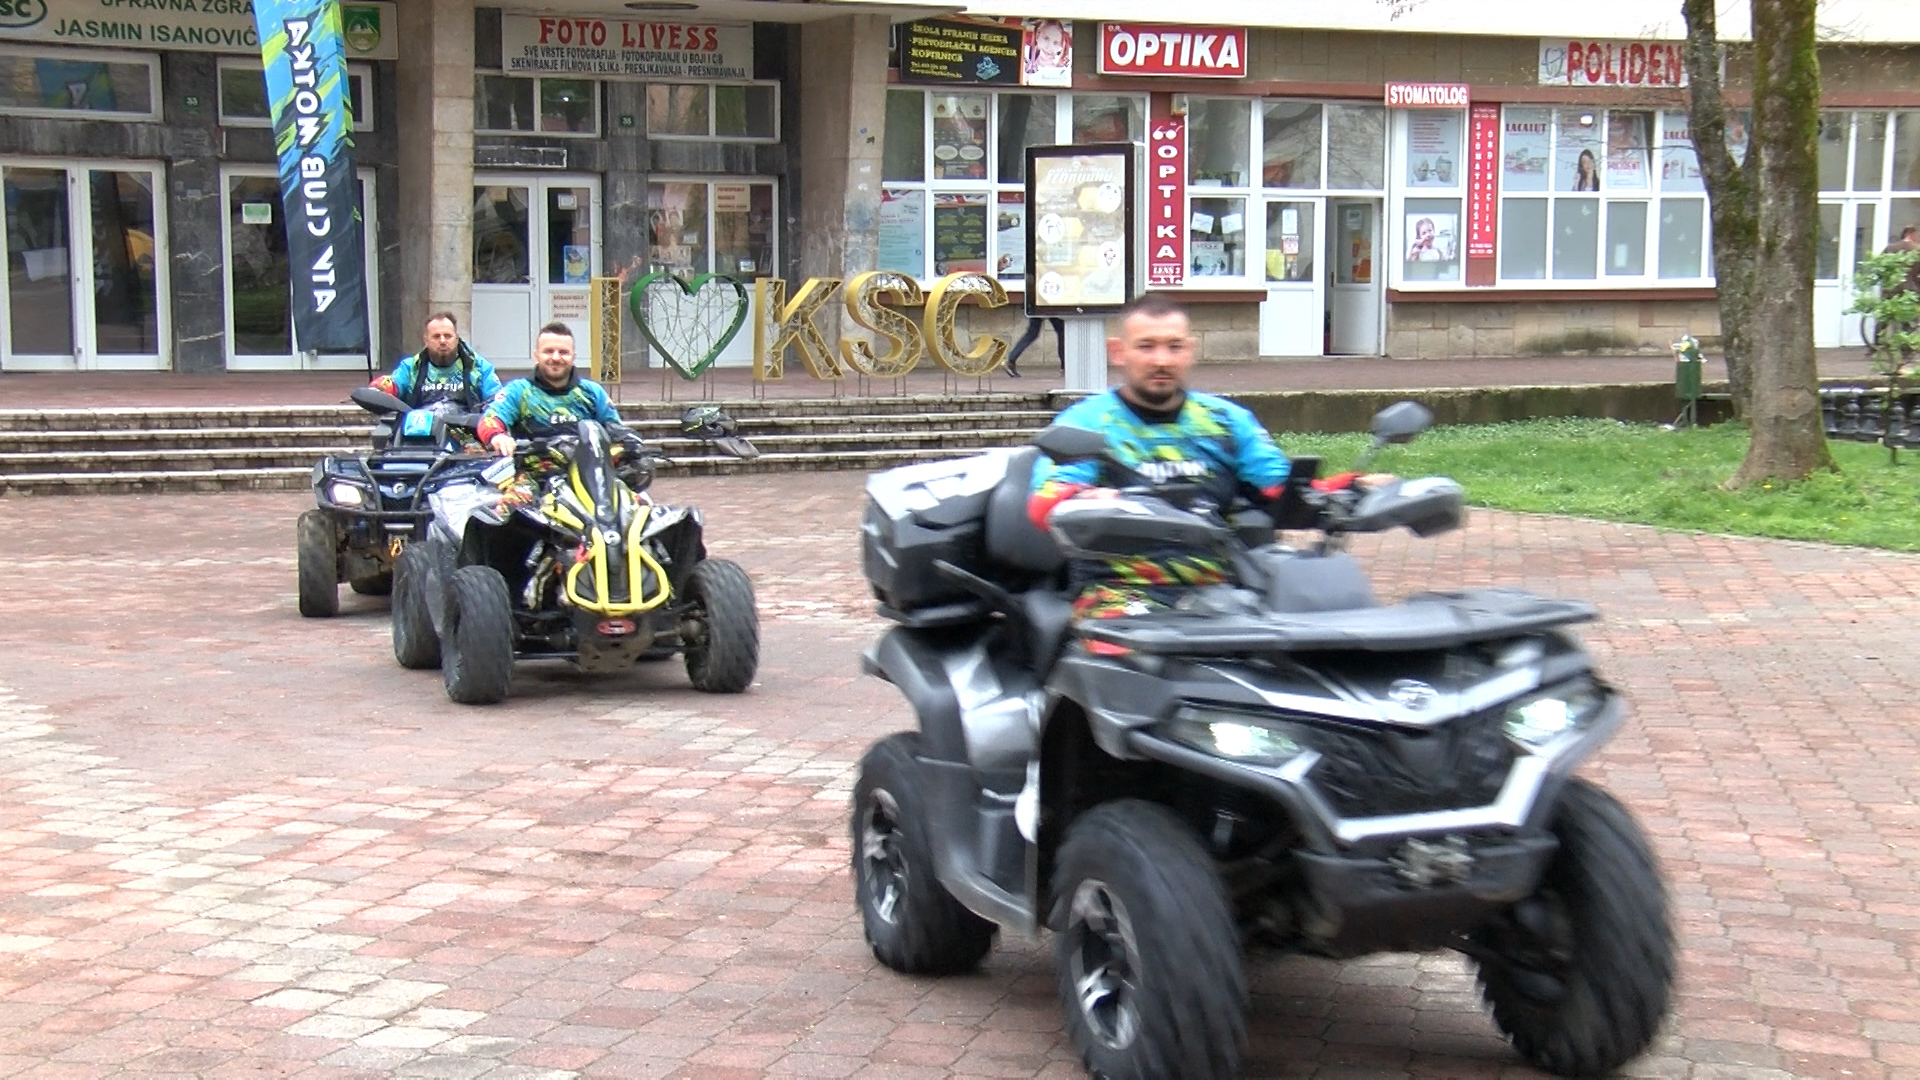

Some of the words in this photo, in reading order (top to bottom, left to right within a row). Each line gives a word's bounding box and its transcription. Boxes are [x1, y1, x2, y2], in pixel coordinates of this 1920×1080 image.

[0, 0, 31, 17] SC
[202, 0, 257, 14] ZGRA
[54, 19, 142, 40] JASMIN
[151, 25, 257, 46] ISANOVIĆ
[539, 19, 606, 46] FOTO
[622, 23, 718, 51] LIVESS
[524, 45, 538, 57] SVE
[541, 46, 564, 58] VRSTE
[682, 53, 688, 64] U
[1110, 32, 1240, 68] OPTIKA
[1567, 41, 1683, 85] POLIDEN
[511, 57, 558, 70] SKENIRANJE
[561, 60, 591, 72] FILMOVA
[599, 61, 619, 73] SLIKA
[1390, 85, 1467, 104] STOMATOLOG
[1156, 145, 1178, 258] OPTIKA
[591, 277, 621, 384] I
[752, 270, 1010, 382] KSC
